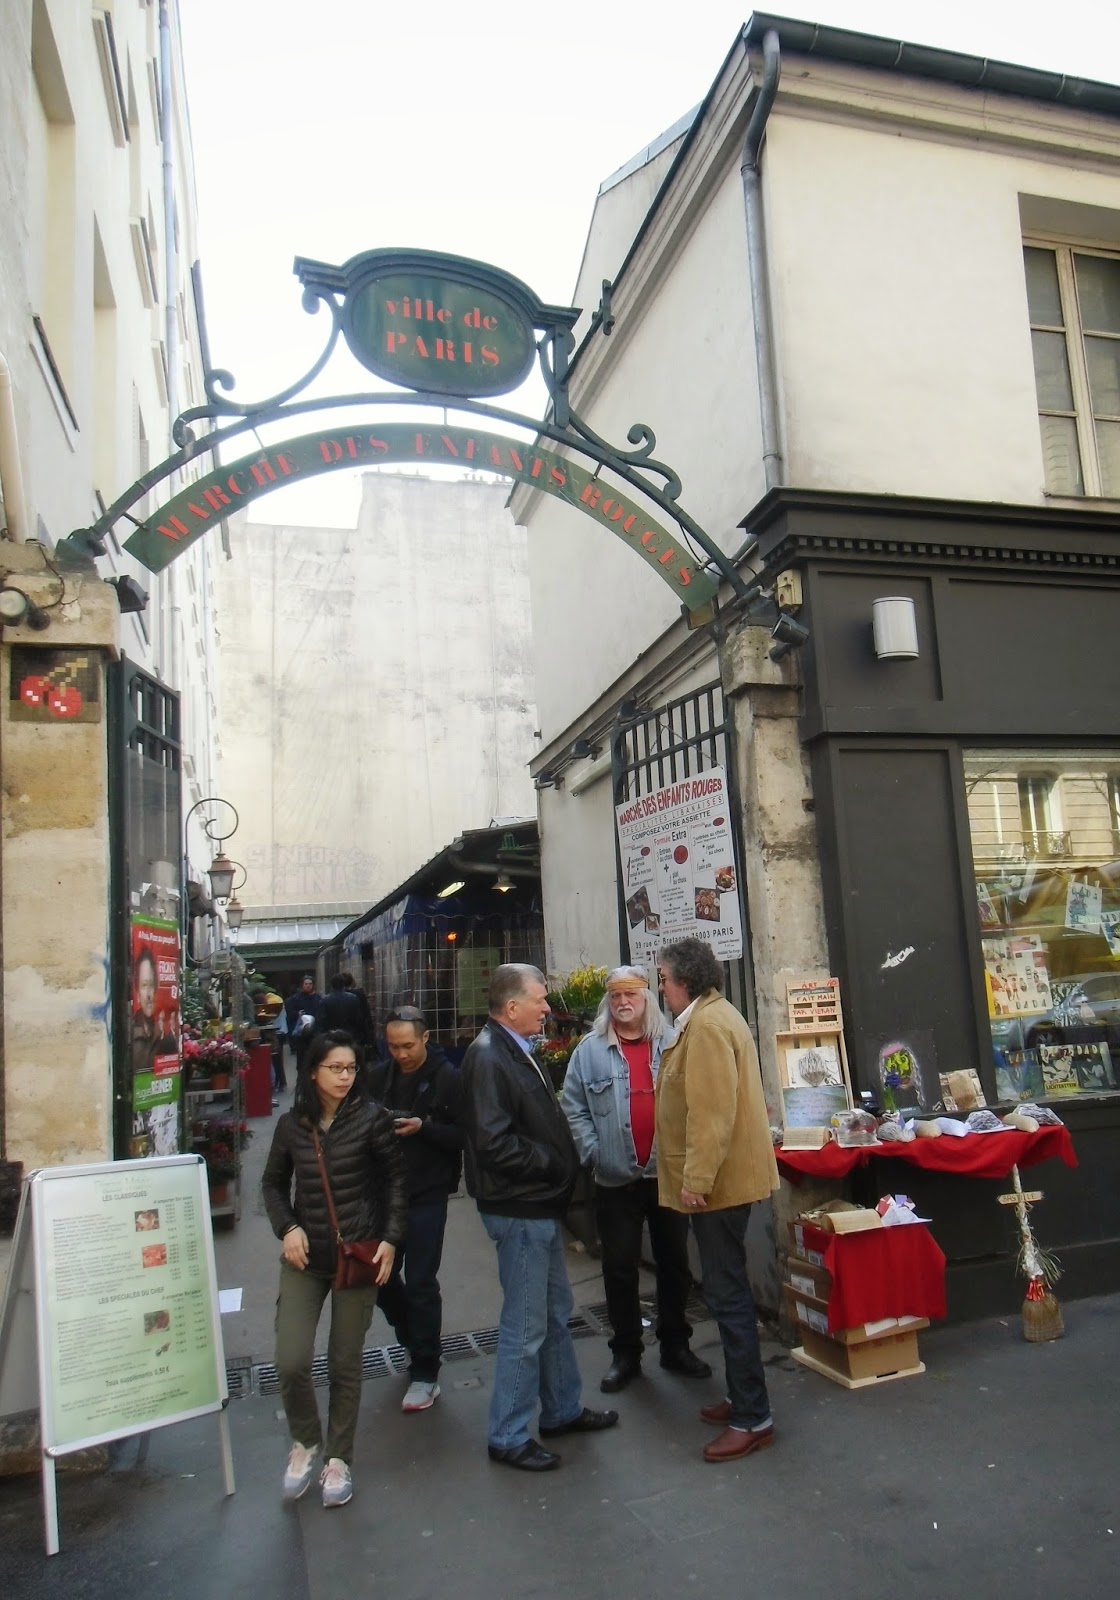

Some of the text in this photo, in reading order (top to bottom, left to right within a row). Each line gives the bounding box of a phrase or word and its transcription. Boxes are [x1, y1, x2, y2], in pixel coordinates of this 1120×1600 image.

[386, 296, 498, 330] ville de
[387, 331, 500, 367] PARIS
[156, 432, 696, 586] MARCHE DES ENFANTS ROUGES
[619, 778, 723, 826] MARCHÉ DES ENFANTS ROUGES
[631, 810, 711, 841] COMPOSEZ VOTRE ASSIETTE
[671, 830, 687, 842] Extra
[643, 940, 653, 948] rue
[712, 926, 734, 937] PARIS
[159, 960, 176, 974] FRONT
[141, 1288, 150, 1297] DU
[150, 1286, 165, 1295] CHEF
